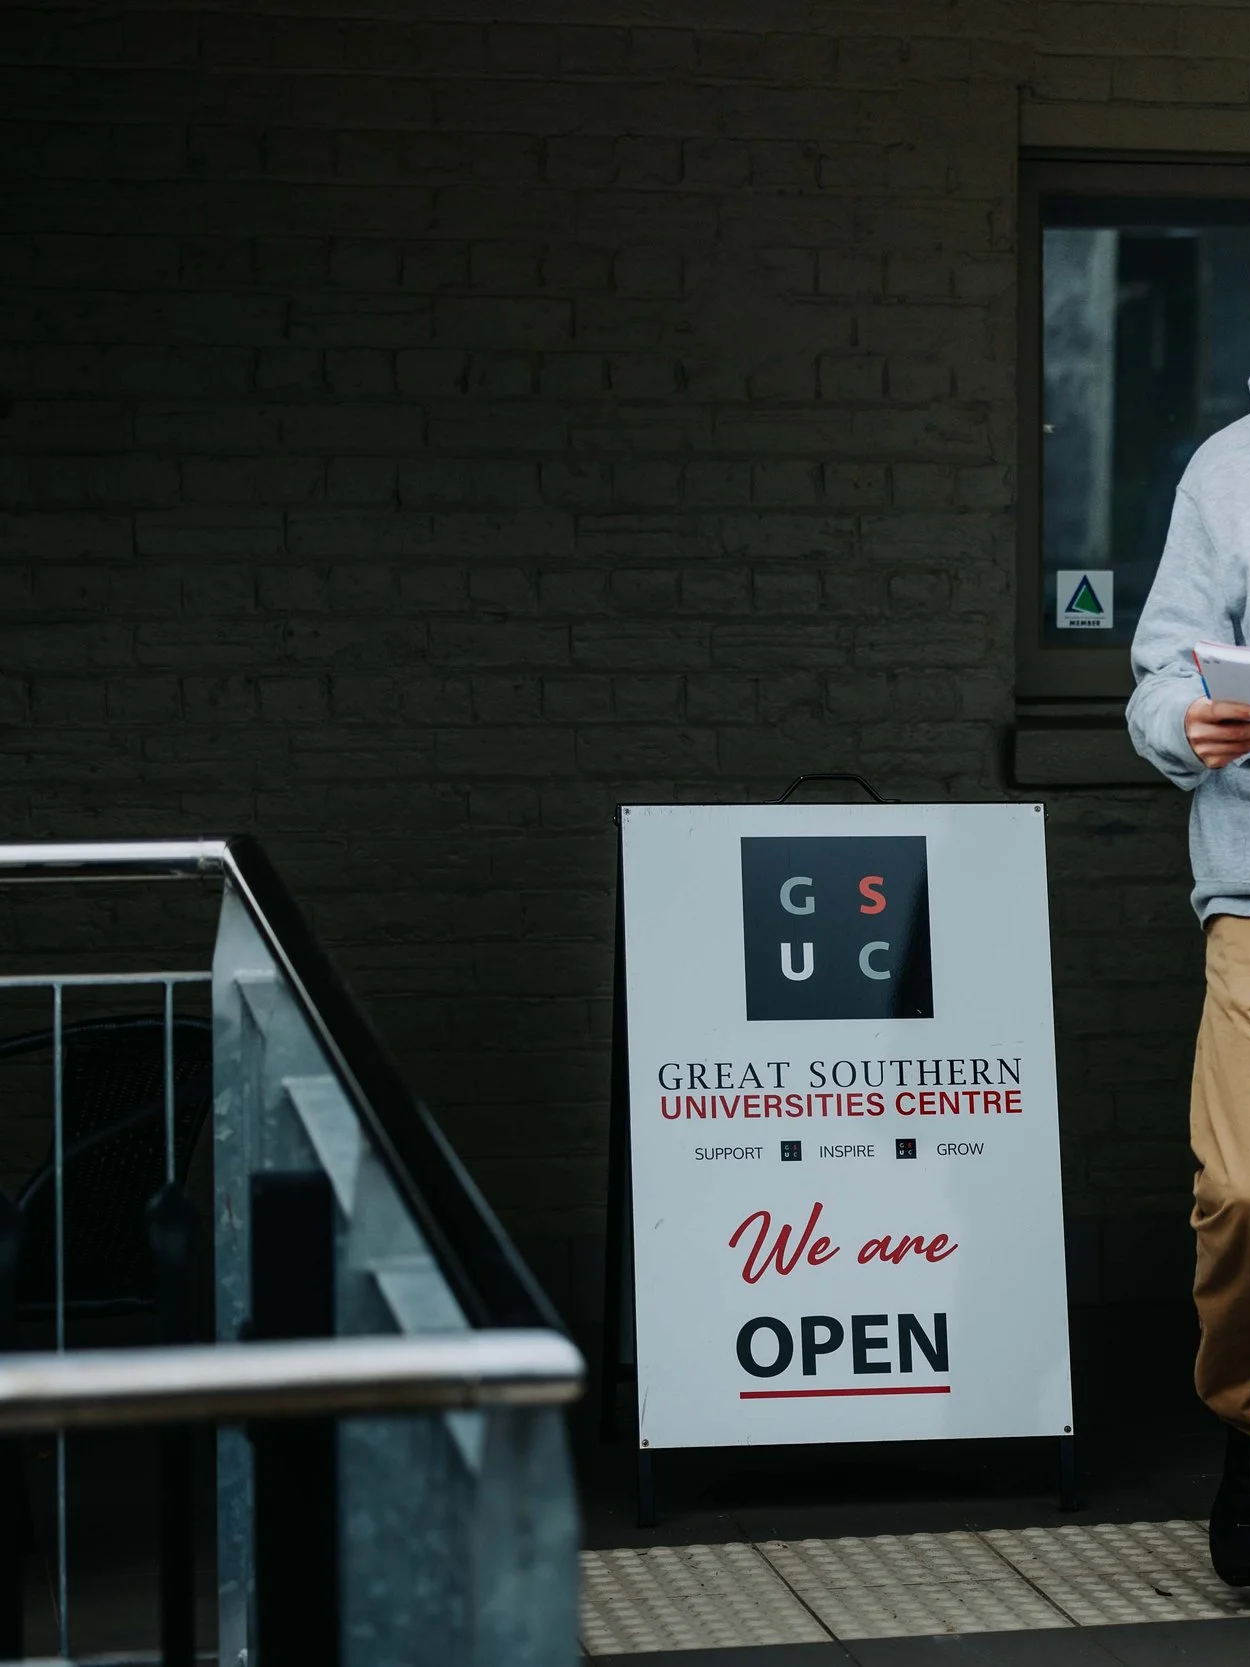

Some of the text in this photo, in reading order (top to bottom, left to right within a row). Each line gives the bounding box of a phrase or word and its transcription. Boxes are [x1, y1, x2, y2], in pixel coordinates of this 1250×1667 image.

[779, 875, 887, 915] G S
[780, 941, 891, 981] U C
[658, 1058, 1022, 1090] GREAT SOUTHERN
[661, 1090, 1023, 1120] UNIVERSITIES CENTRE
[695, 1142, 984, 1160] SUPPORT INSPIRE GROW
[728, 1202, 958, 1284] We are
[736, 1312, 949, 1378] OPEN
